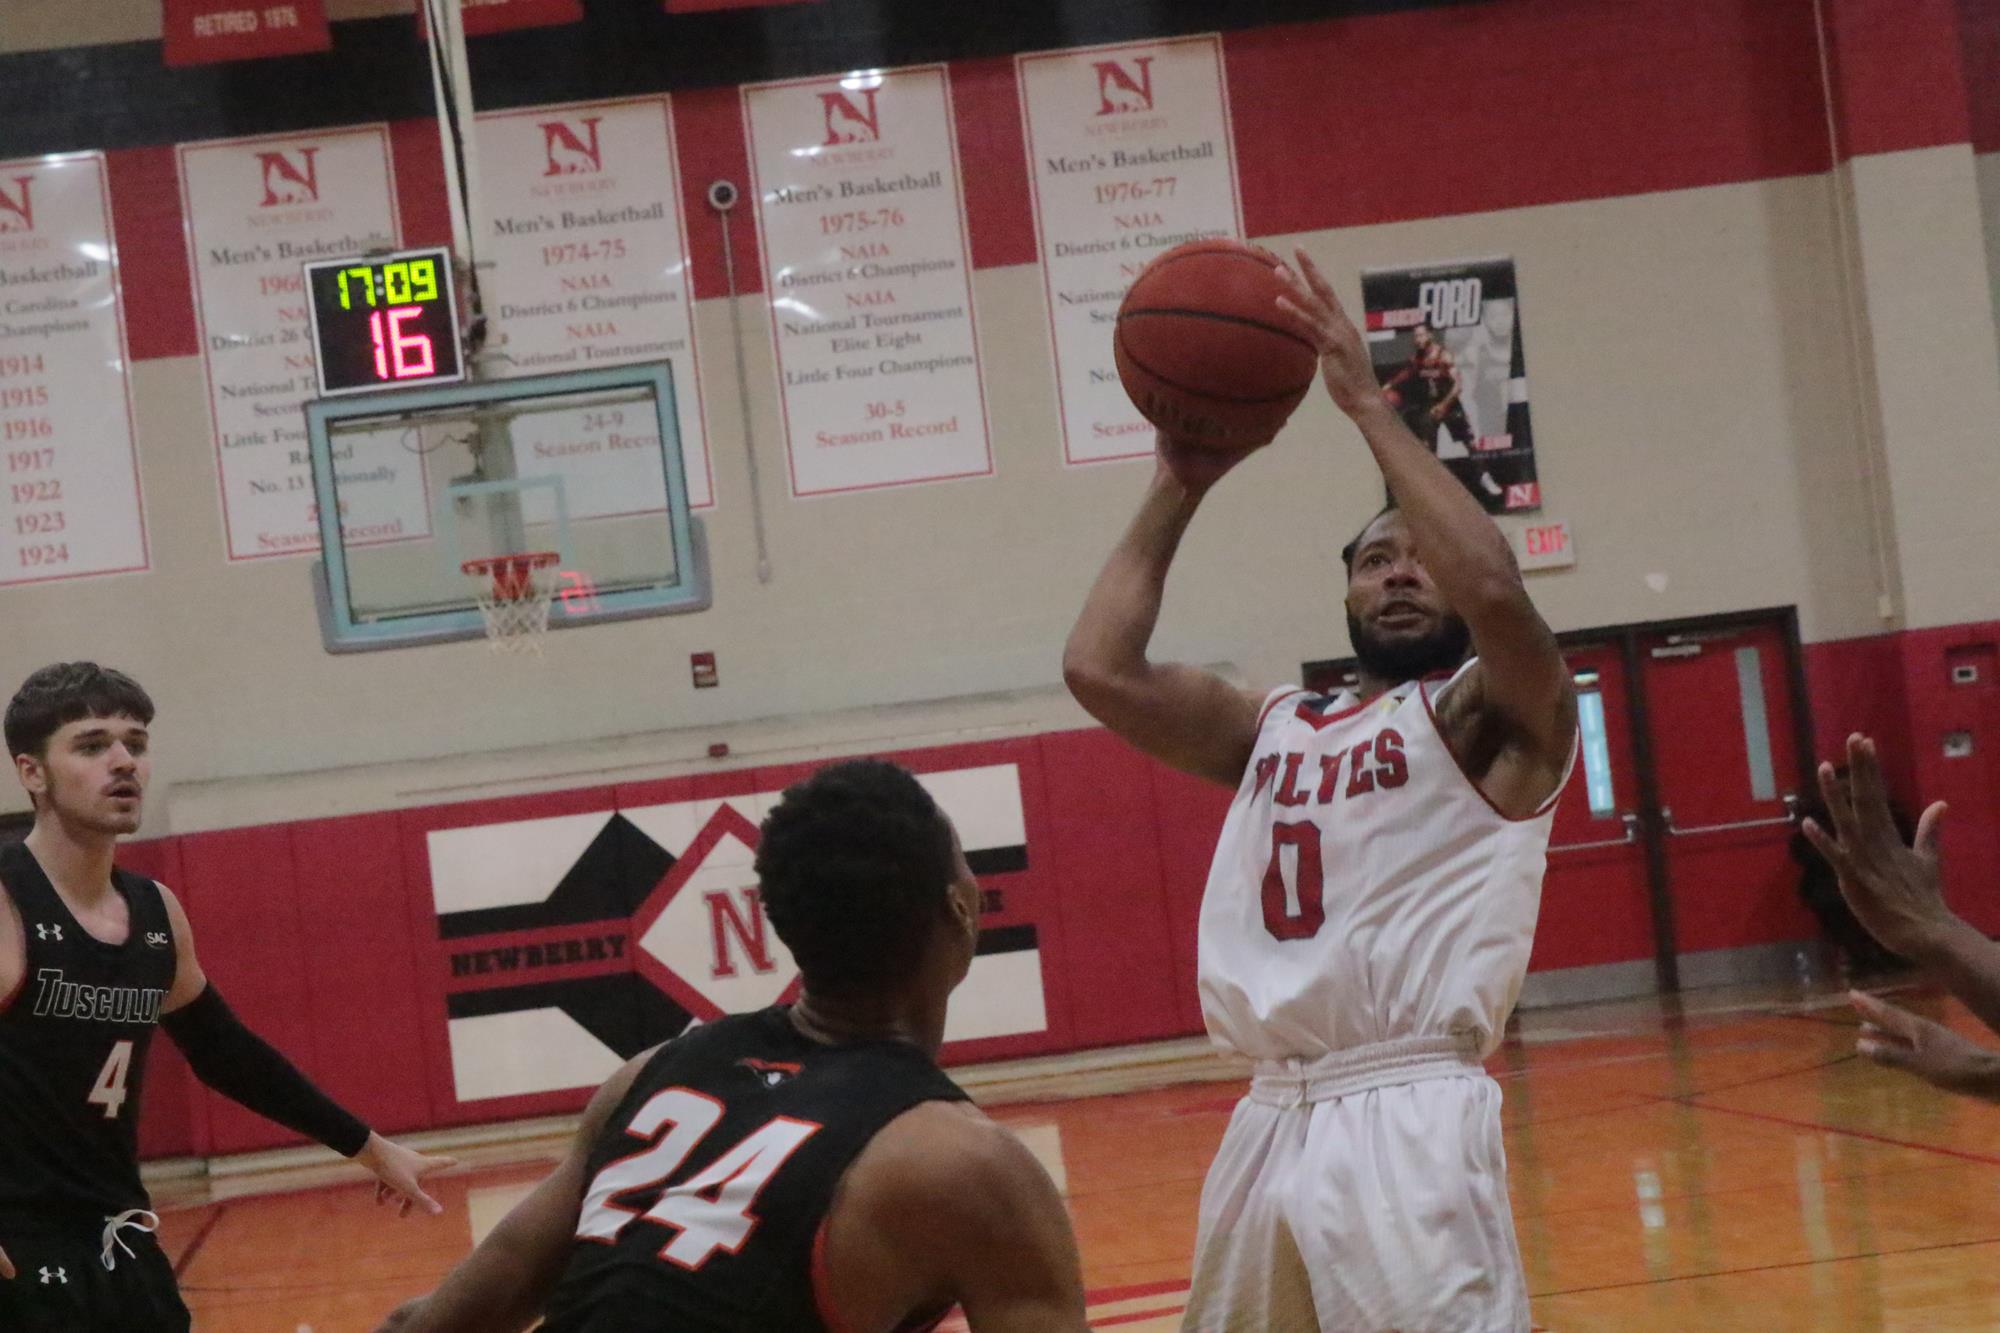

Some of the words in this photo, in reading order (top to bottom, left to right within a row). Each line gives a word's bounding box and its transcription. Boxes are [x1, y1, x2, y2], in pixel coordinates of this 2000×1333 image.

[1047, 155, 1107, 175] Men's
[1113, 141, 1213, 168] Basketball
[774, 183, 832, 205] Men's
[839, 171, 941, 198] Basketball
[1093, 177, 1177, 204] 1976-77
[493, 215, 554, 235] Men's
[561, 202, 663, 229] Basketball
[819, 209, 904, 234] 1975-76
[1114, 212, 1164, 229] NAIA
[210, 246, 272, 266] Men's
[541, 239, 626, 266] 1974-75
[840, 242, 890, 260] NAIA
[561, 274, 612, 292] NAIA
[861, 258, 955, 279] Champions
[337, 260, 438, 310] 17:09
[845, 291, 895, 307] NAIA
[500, 300, 562, 320] District
[582, 290, 677, 311] Champions
[1419, 278, 1481, 328] FORD
[566, 322, 617, 339] NAIA
[783, 317, 856, 336] National
[861, 306, 963, 329] Tournament
[370, 305, 434, 379] 16
[879, 355, 974, 375] Champions
[220, 379, 294, 399] National
[815, 430, 883, 448] Season
[890, 416, 960, 440] Record
[1261, 819, 1326, 942] 0
[145, 931, 169, 945] SAC
[702, 886, 777, 980] N
[450, 935, 626, 978] NEWBERRY
[87, 1040, 133, 1119] 4
[575, 1085, 824, 1271] 24
